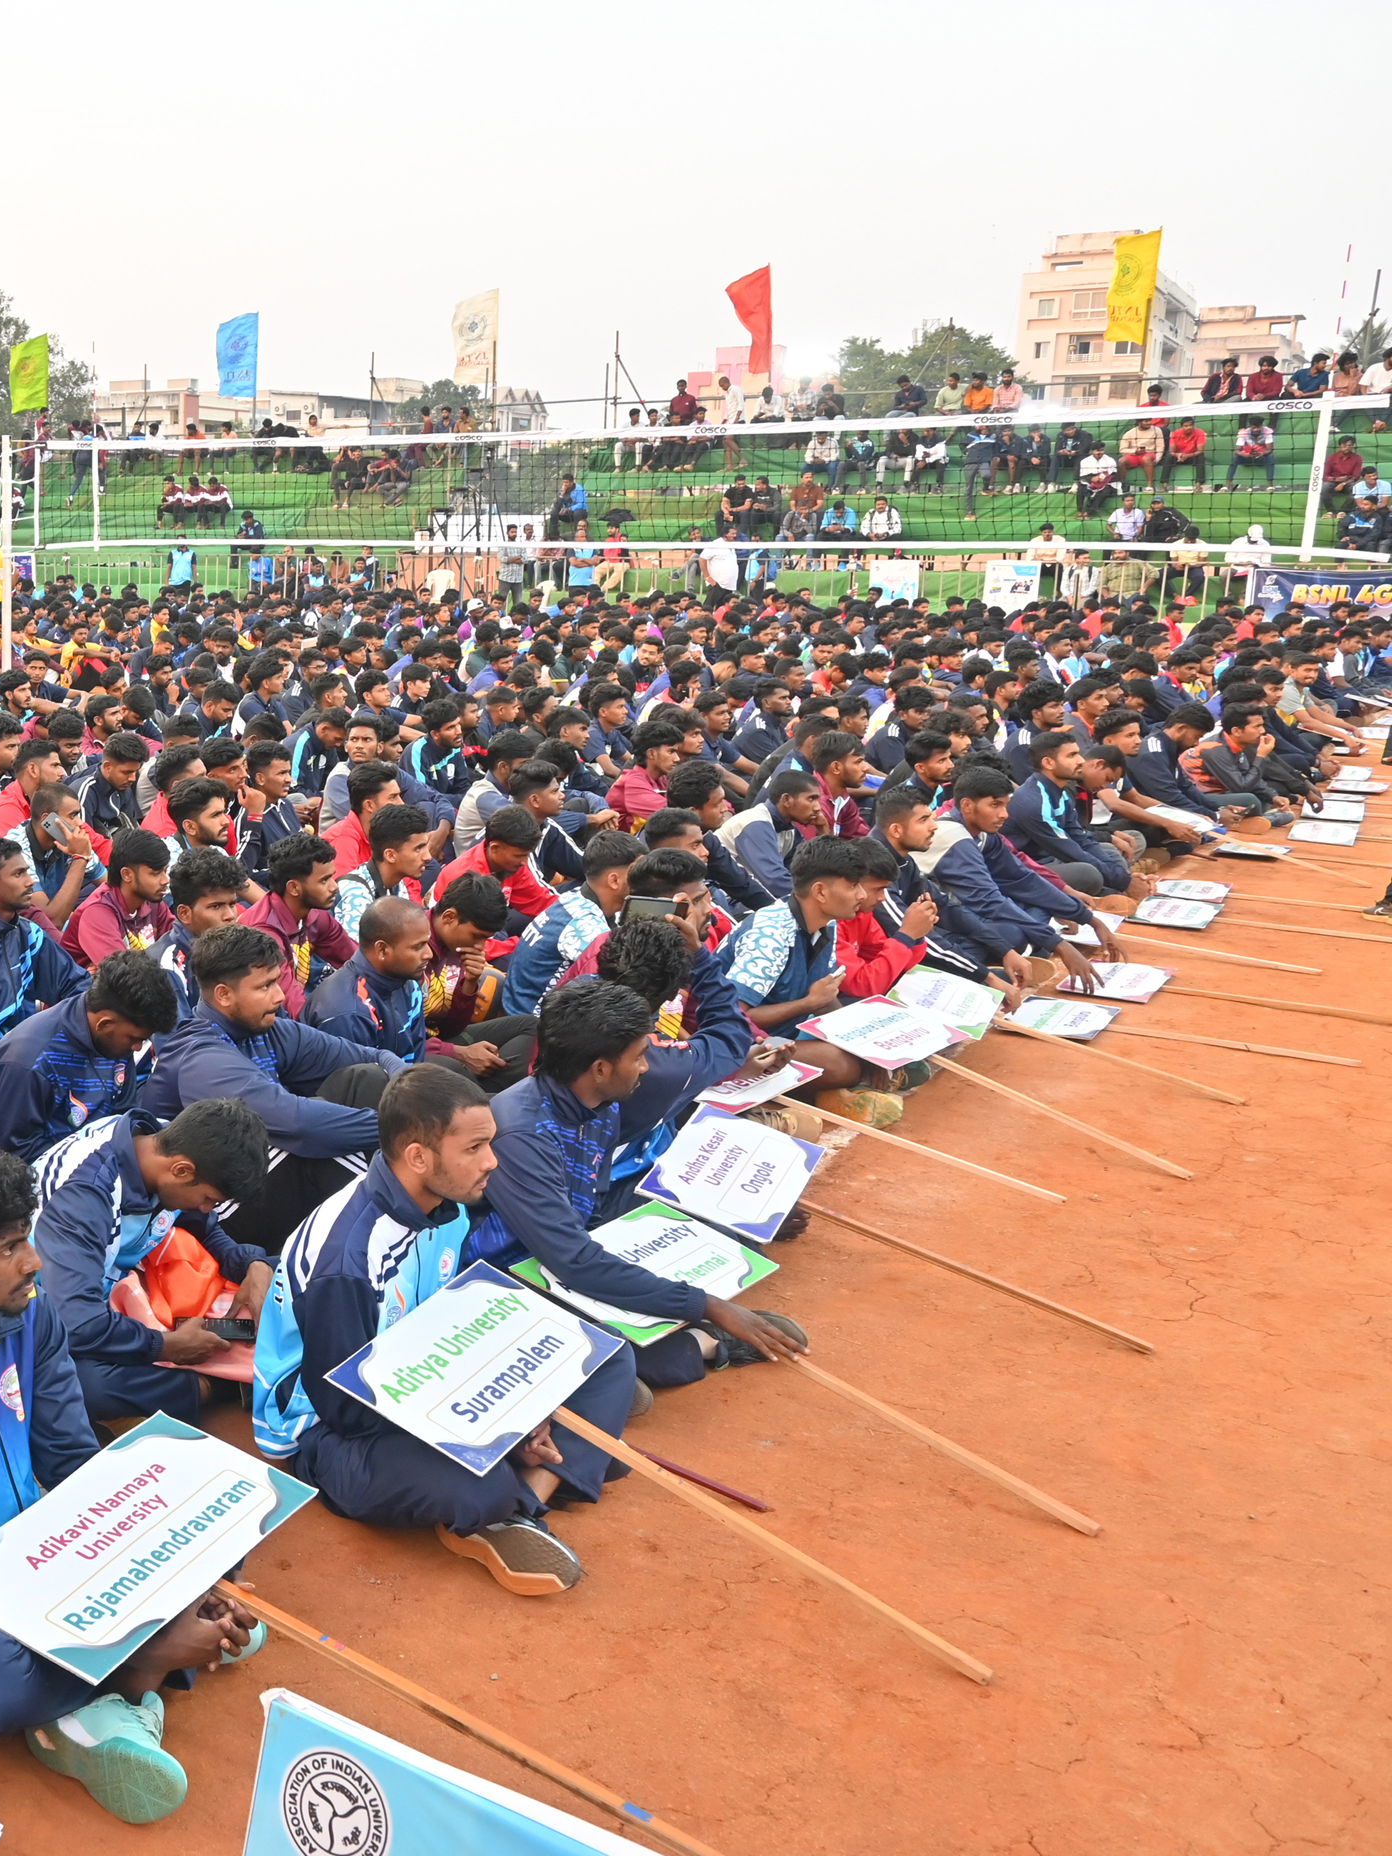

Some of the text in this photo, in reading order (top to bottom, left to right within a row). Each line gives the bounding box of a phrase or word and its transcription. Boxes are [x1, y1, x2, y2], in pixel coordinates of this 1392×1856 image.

[974, 416, 1012, 424] COSCO
[1267, 401, 1313, 411] COSCO
[694, 426, 727, 434] COSCO
[1311, 465, 1321, 492] COSCO
[1291, 584, 1352, 605] BSNL
[1355, 584, 1392, 605] 4G
[834, 1008, 917, 1044] Bangalore University
[873, 1025, 931, 1051] Bengaluru
[678, 1128, 728, 1185] Andhra Kesari
[704, 1144, 748, 1186] University
[740, 1161, 776, 1194] Ongole
[617, 1223, 698, 1264] University
[673, 1251, 730, 1284] Chennai
[380, 1292, 530, 1404] Aditya University
[450, 1334, 565, 1424] Surampalem
[25, 1463, 166, 1571] Adikavi Nannaya
[75, 1493, 169, 1561] University
[63, 1479, 257, 1632] Rajamahendravaram
[288, 1757, 384, 1856] ASSOCIATION OF INDIAN UNIVERS
